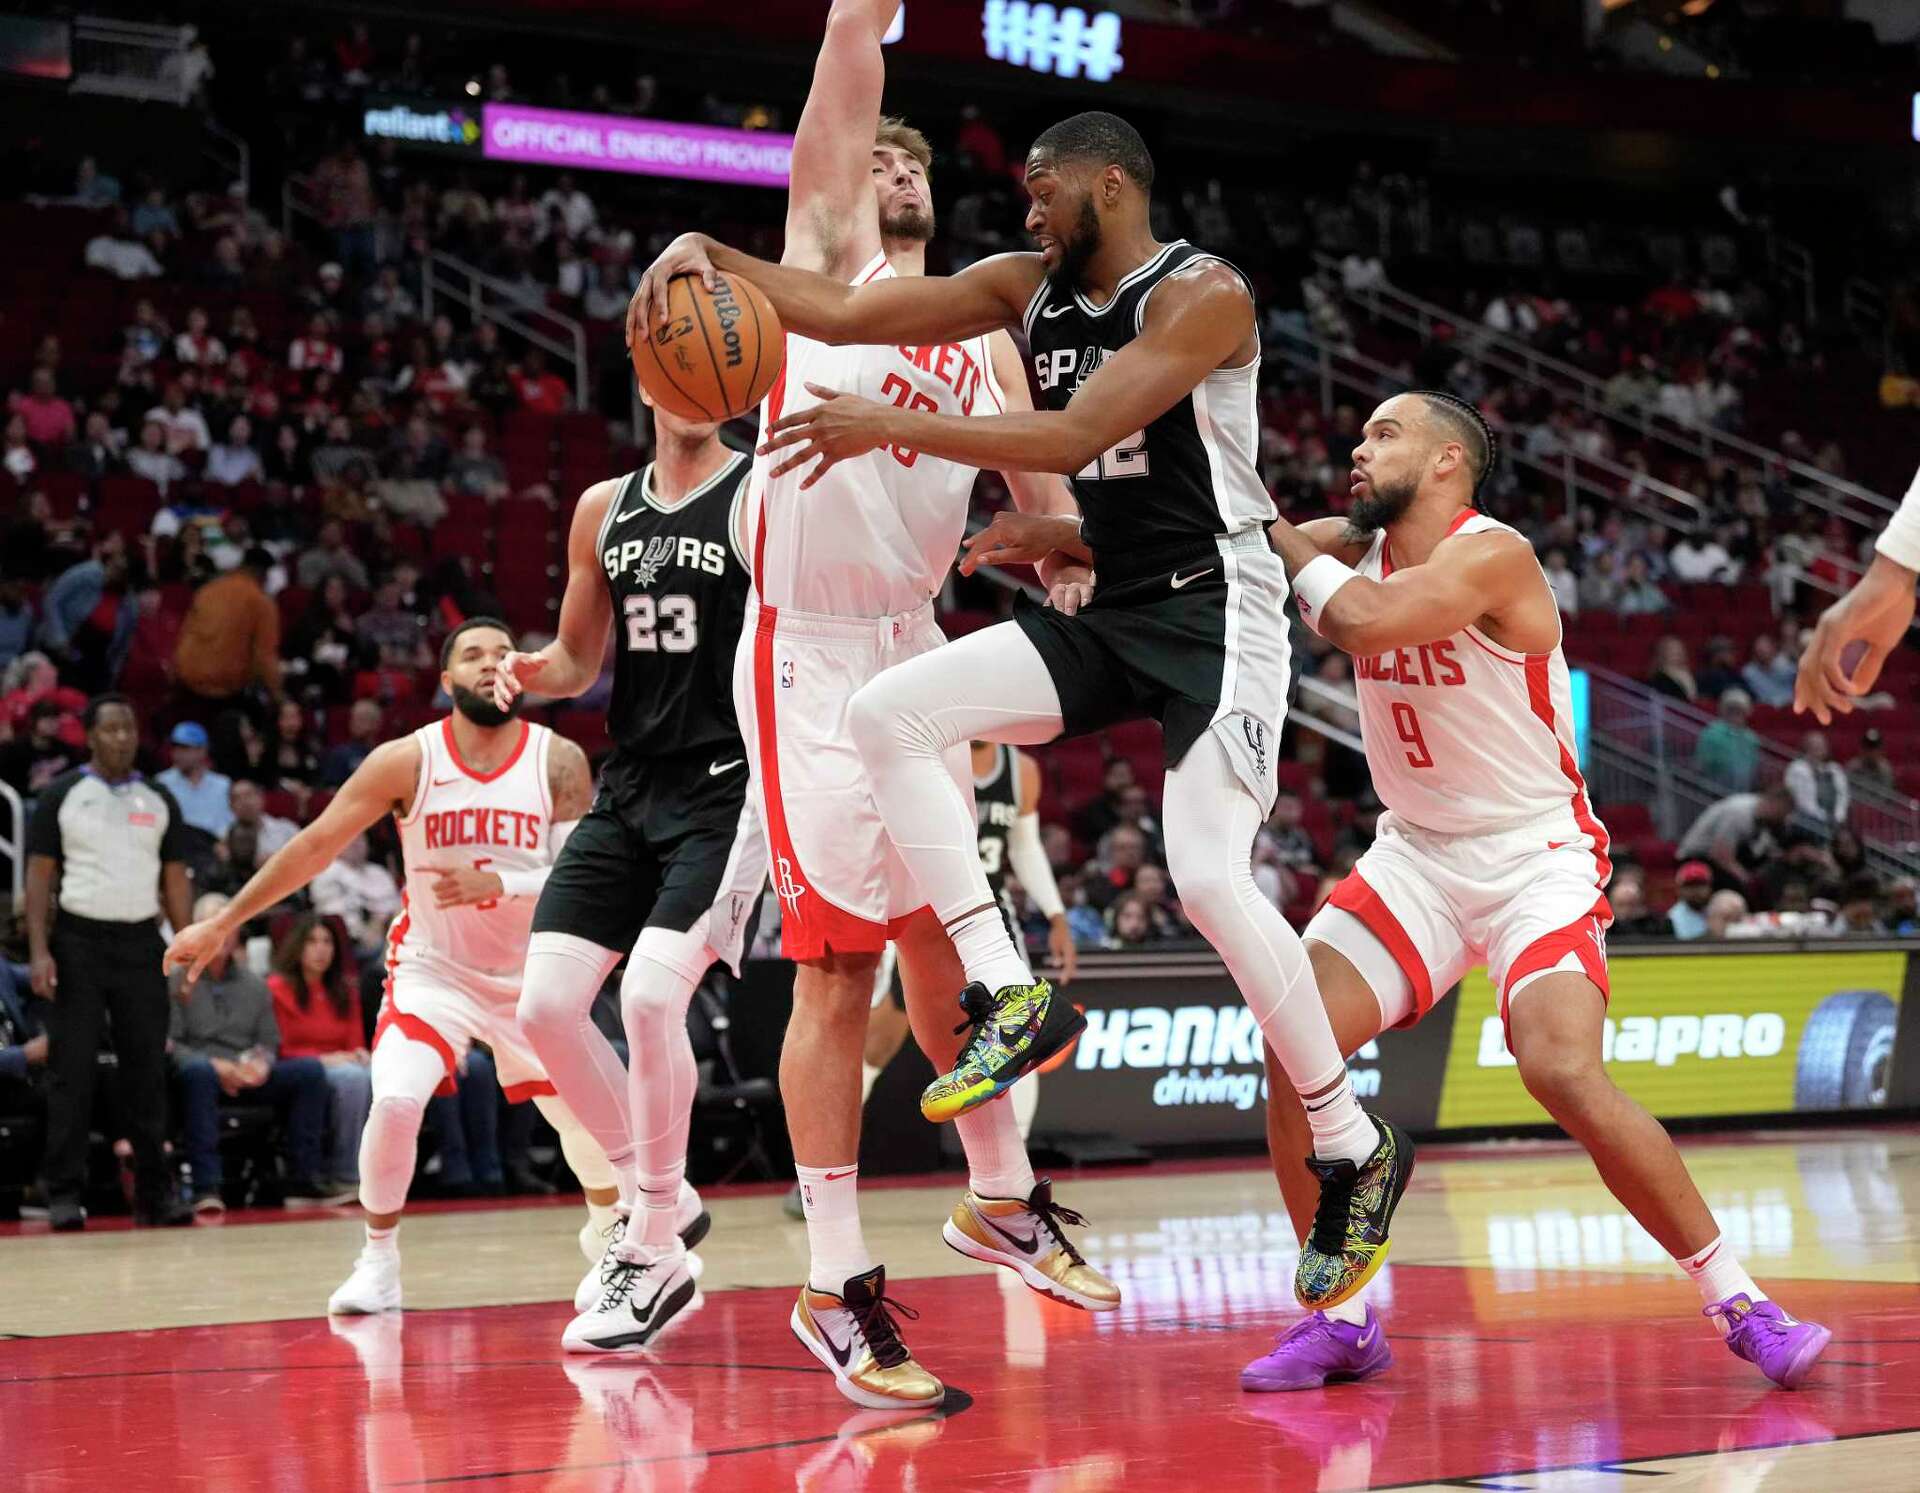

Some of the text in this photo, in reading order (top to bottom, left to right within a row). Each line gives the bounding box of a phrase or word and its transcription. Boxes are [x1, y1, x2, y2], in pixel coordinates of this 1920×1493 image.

[491, 117, 793, 176] OFFICIAL ENERGY PROVID
[604, 536, 726, 589] SPURS
[623, 594, 698, 653] 23
[1392, 702, 1434, 768] 9
[425, 807, 541, 850] ROCKETS
[1153, 1068, 1258, 1111] driving
